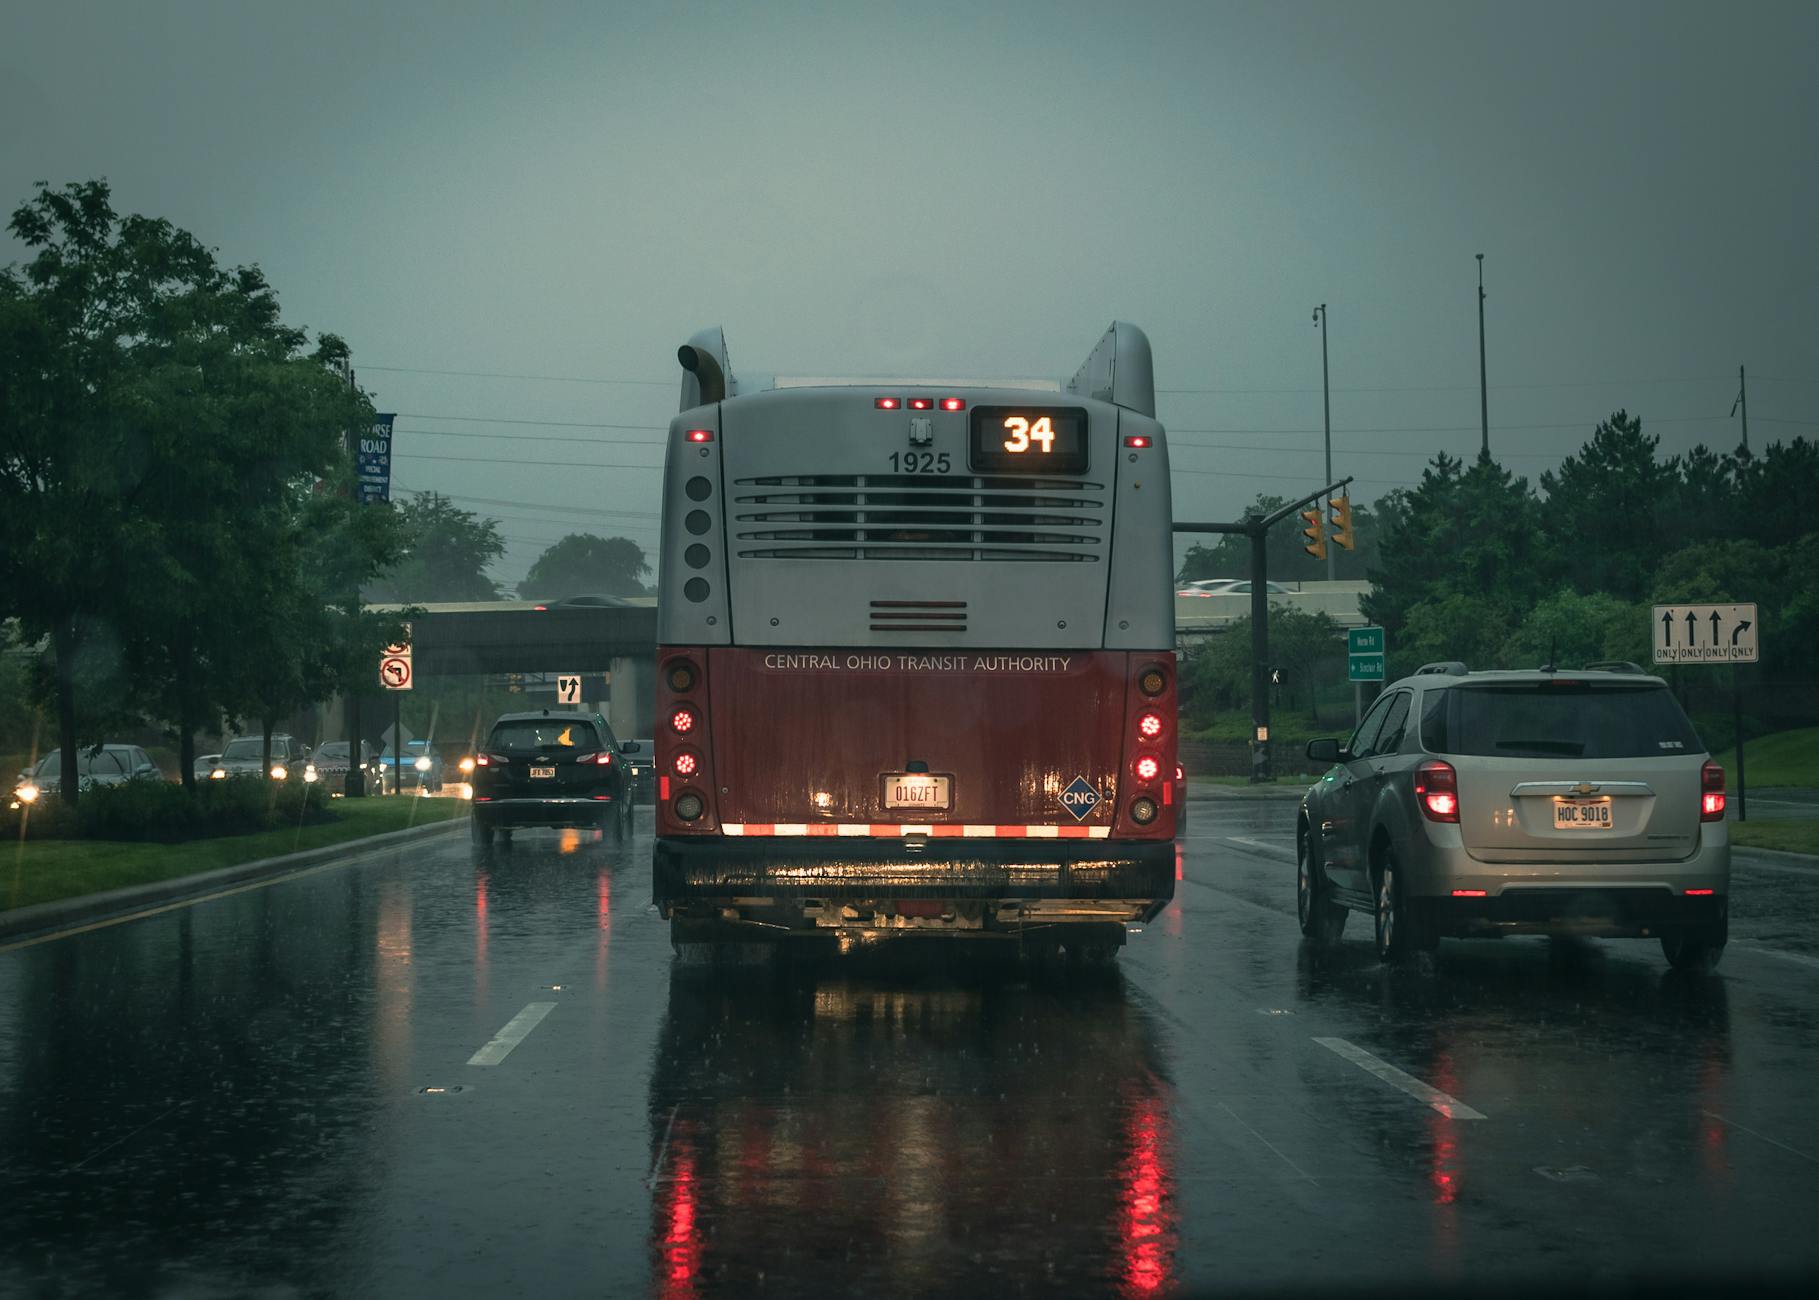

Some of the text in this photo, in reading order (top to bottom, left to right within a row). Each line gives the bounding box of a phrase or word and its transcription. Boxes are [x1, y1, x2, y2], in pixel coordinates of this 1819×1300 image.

[1004, 416, 1055, 453] 34
[361, 439, 387, 453] ROAD
[889, 452, 950, 473] 1925
[1656, 647, 1753, 658] ONLY ONLY ONLY ONLY
[765, 654, 1071, 671] CENTRAL OHIO TRANSIT AUTHORITY
[1063, 792, 1095, 804] CNG
[1581, 807, 1608, 821] 9018
